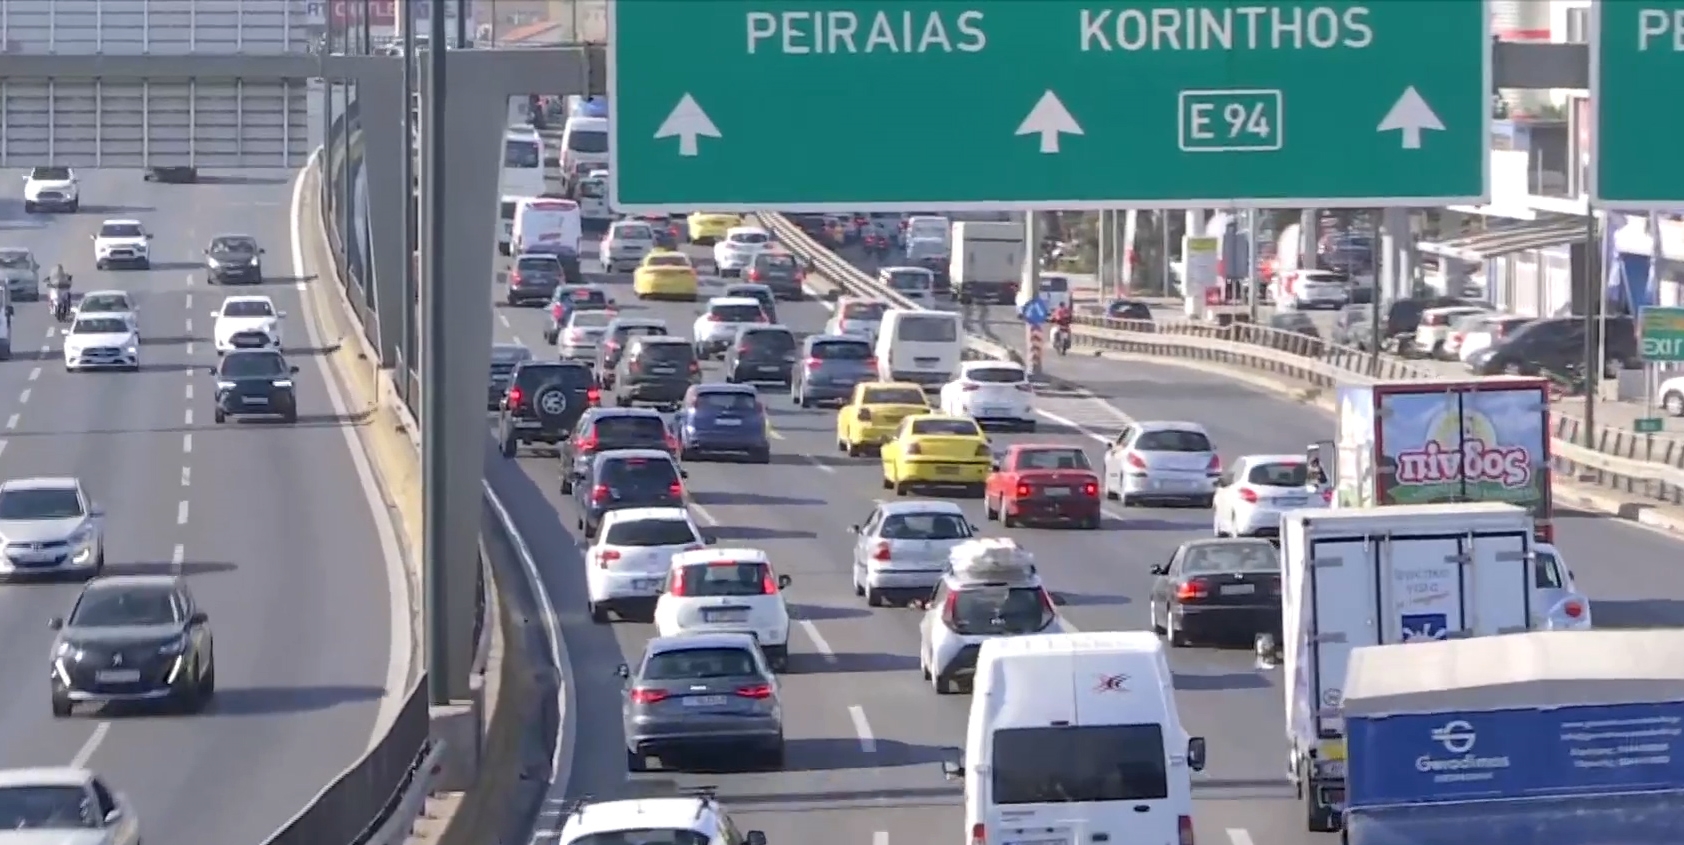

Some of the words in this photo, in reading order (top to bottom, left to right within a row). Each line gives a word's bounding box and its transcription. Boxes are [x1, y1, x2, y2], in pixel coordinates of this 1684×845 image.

[747, 10, 986, 53] PEIRAIAS
[1080, 7, 1373, 50] KORINTHOS
[1190, 103, 1215, 139] E
[1223, 102, 1271, 138] 94
